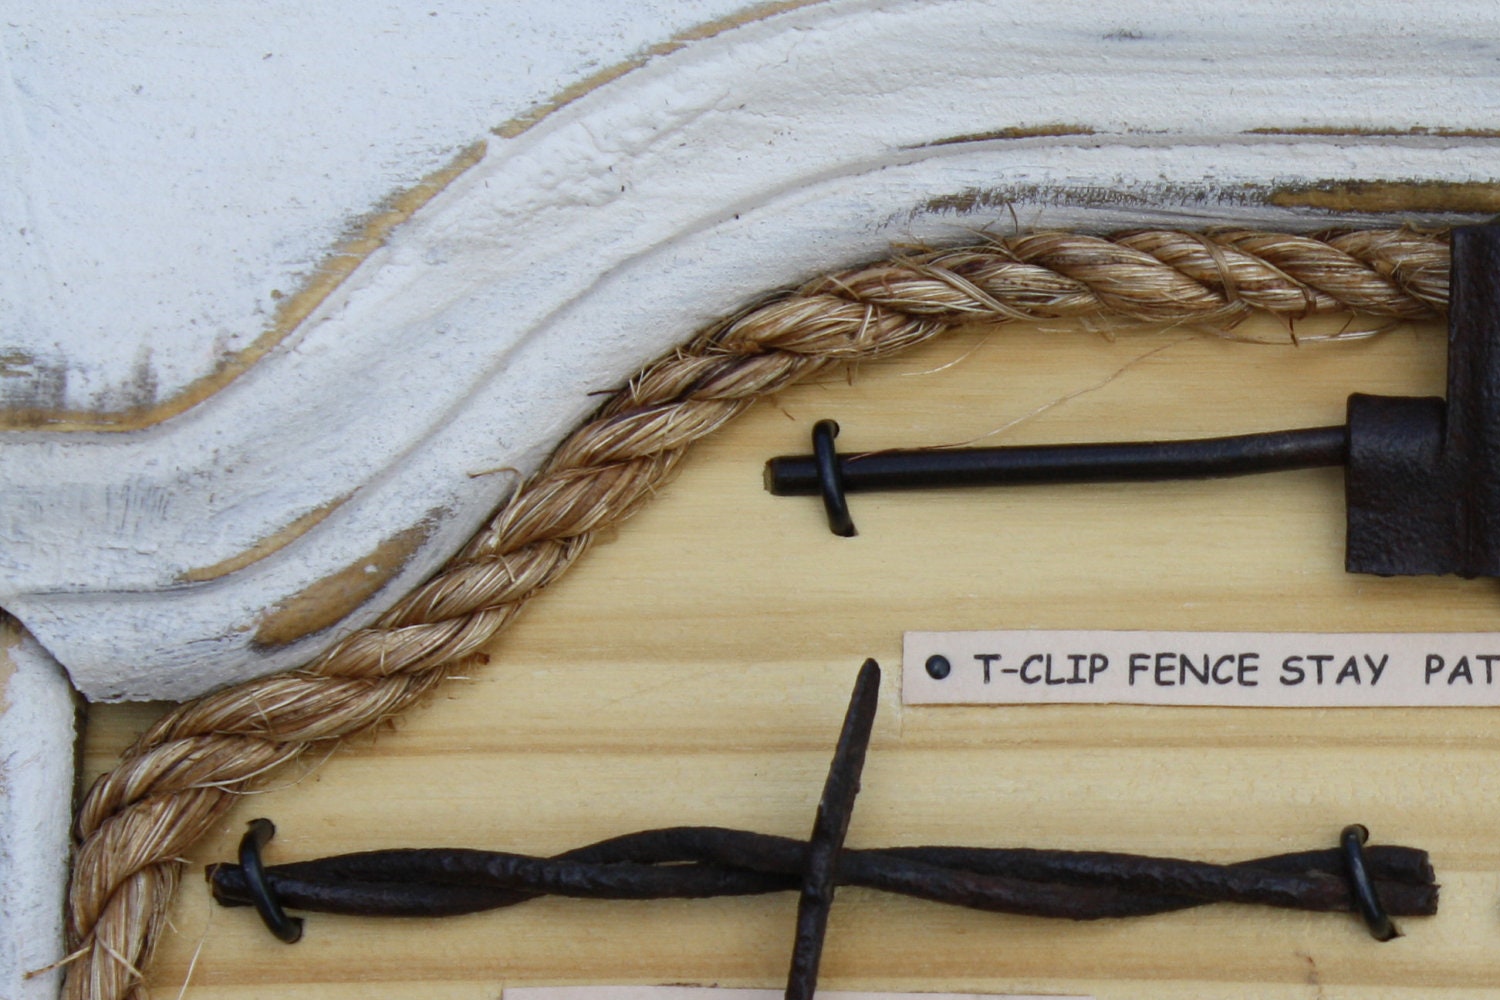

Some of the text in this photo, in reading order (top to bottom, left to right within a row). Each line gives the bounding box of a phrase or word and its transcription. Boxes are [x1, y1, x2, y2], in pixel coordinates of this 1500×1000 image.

[973, 653, 1109, 687] T-CLIP
[1128, 652, 1260, 687] FENCE
[1279, 654, 1389, 686] STAY
